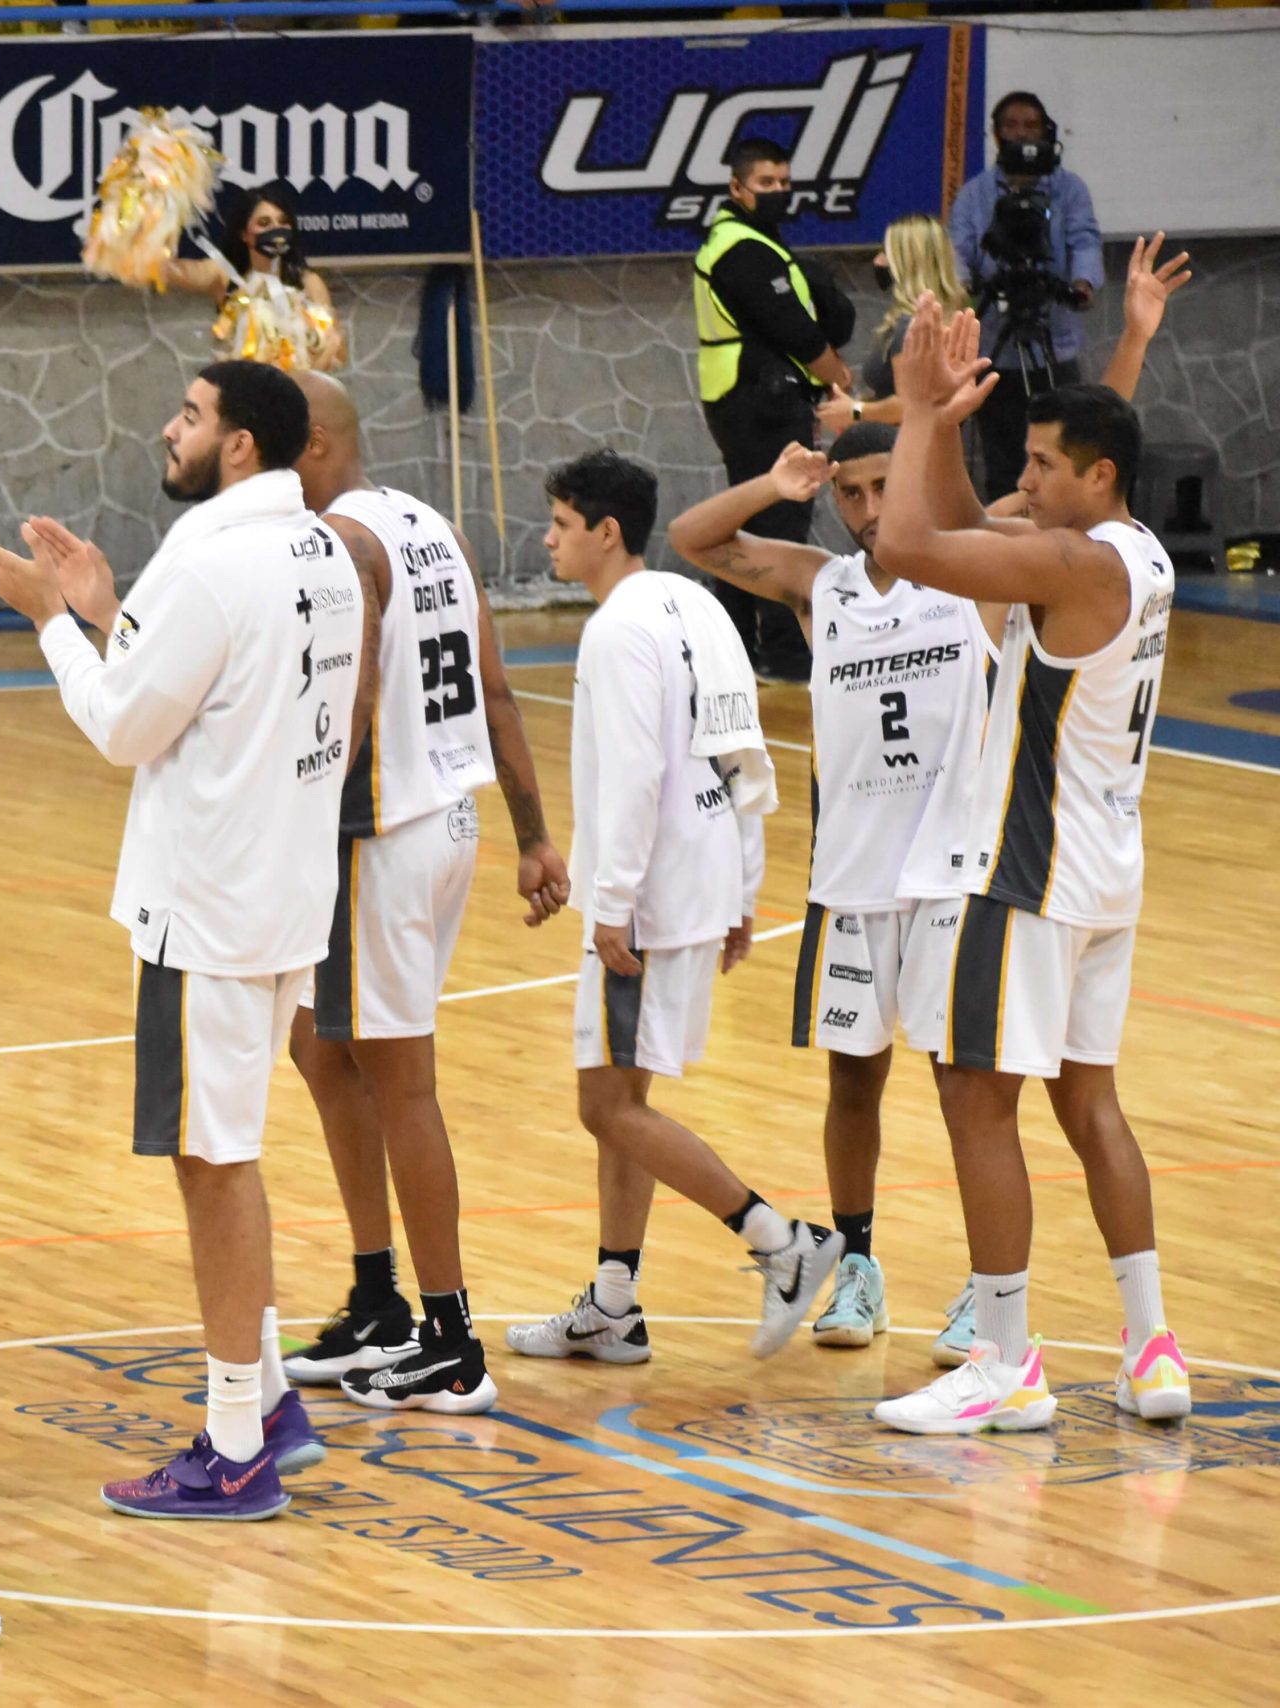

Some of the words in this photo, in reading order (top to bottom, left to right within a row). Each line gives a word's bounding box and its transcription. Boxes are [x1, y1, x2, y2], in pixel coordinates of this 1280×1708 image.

[540, 50, 915, 192] udi
[297, 215, 329, 231] TODO
[332, 214, 357, 230] CON
[361, 212, 409, 228] MEDIDA
[666, 185, 855, 228] sprt
[316, 653, 353, 675] STRENDUS
[419, 629, 475, 724] 23
[830, 643, 962, 685] PANTERAS
[844, 667, 941, 693] AGUASCALIENTES
[880, 691, 910, 742] 2
[1128, 680, 1153, 764] 4
[32, 1343, 1006, 1628] AGASCALIENTES
